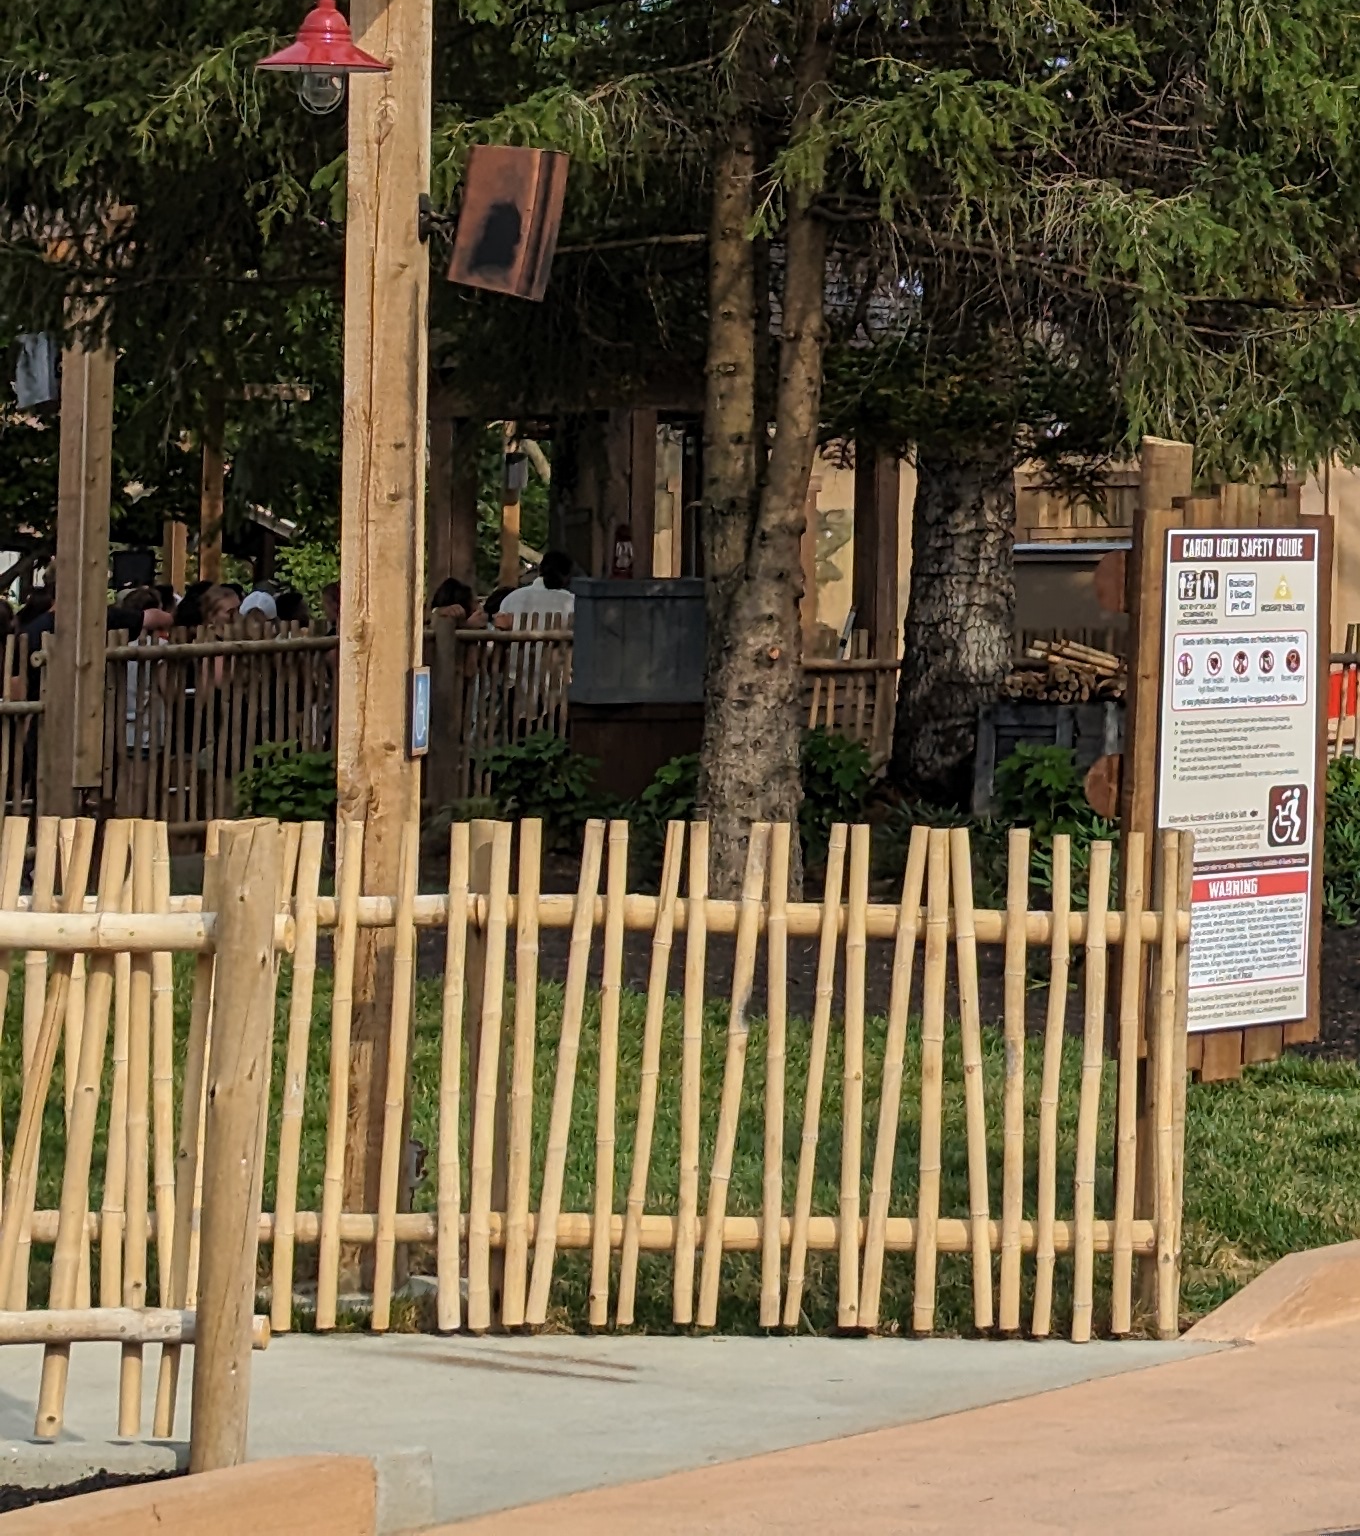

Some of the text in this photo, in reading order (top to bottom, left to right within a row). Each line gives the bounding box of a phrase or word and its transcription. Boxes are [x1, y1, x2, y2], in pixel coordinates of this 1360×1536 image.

[1182, 538, 1303, 558] CARGO LOCO SAFETY GUIDE
[1208, 877, 1258, 898] WARNING
